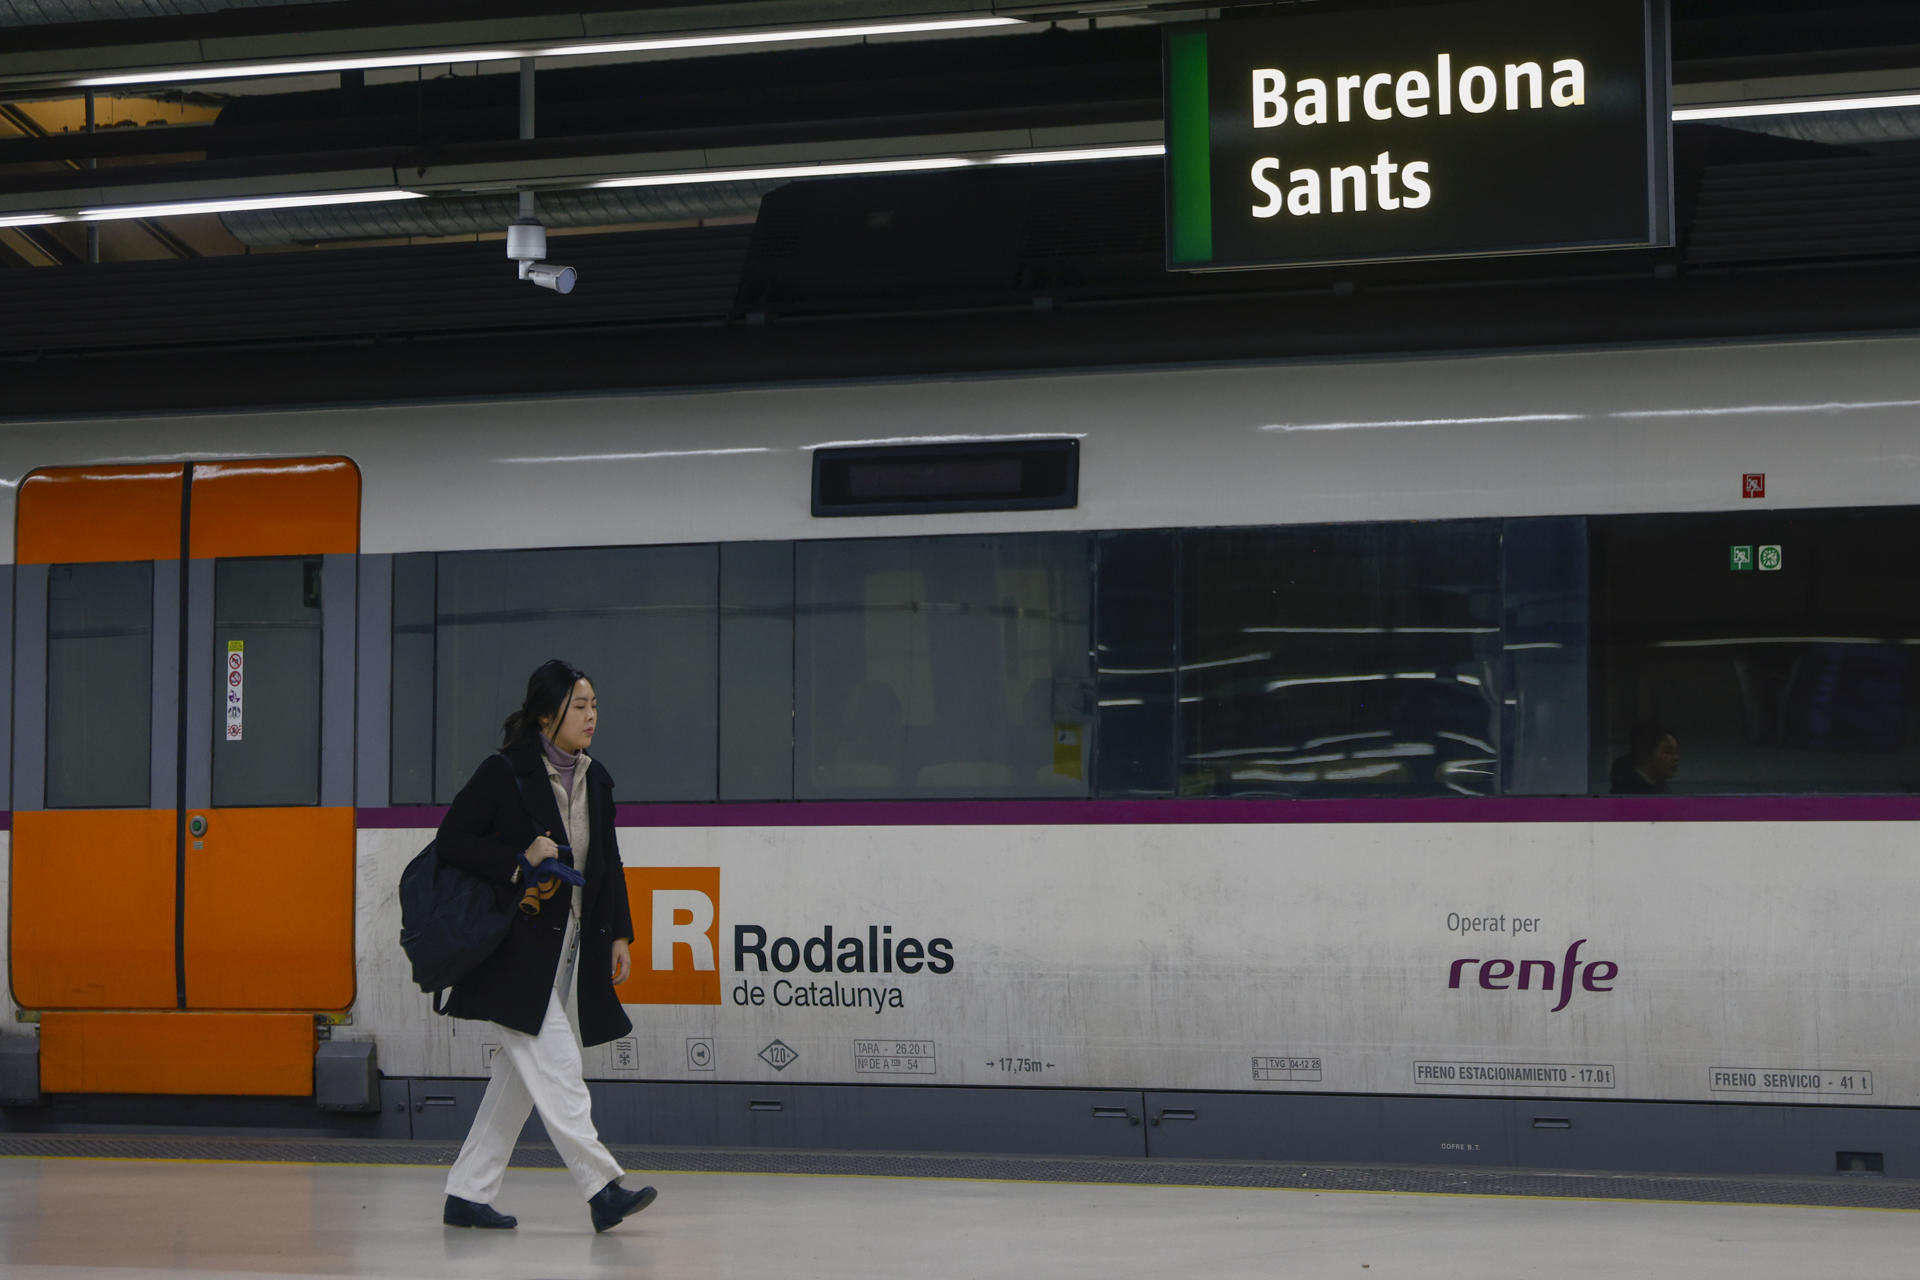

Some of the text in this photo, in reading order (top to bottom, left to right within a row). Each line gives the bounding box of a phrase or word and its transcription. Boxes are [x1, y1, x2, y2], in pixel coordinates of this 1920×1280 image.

[1252, 53, 1585, 129] Barcelona
[1251, 151, 1432, 218] Sants
[651, 889, 716, 971] R
[1447, 912, 1541, 937] Operat per
[734, 925, 955, 974] Rodalies
[1448, 939, 1619, 1012] renfe
[733, 980, 904, 1014] de Catalunya
[770, 1047, 786, 1063] 120
[856, 1042, 880, 1054] TARA
[895, 1043, 920, 1055] 26.20
[869, 1058, 881, 1069] DE
[907, 1059, 919, 1070] 54
[999, 1057, 1042, 1074] 17,75m
[1418, 1065, 1455, 1080] FRENO
[1459, 1066, 1567, 1082] ESTACIONAMIENTO
[1715, 1072, 1757, 1087] FRENO
[1764, 1073, 1821, 1088] SERVICIO
[1840, 1076, 1854, 1089] 41
